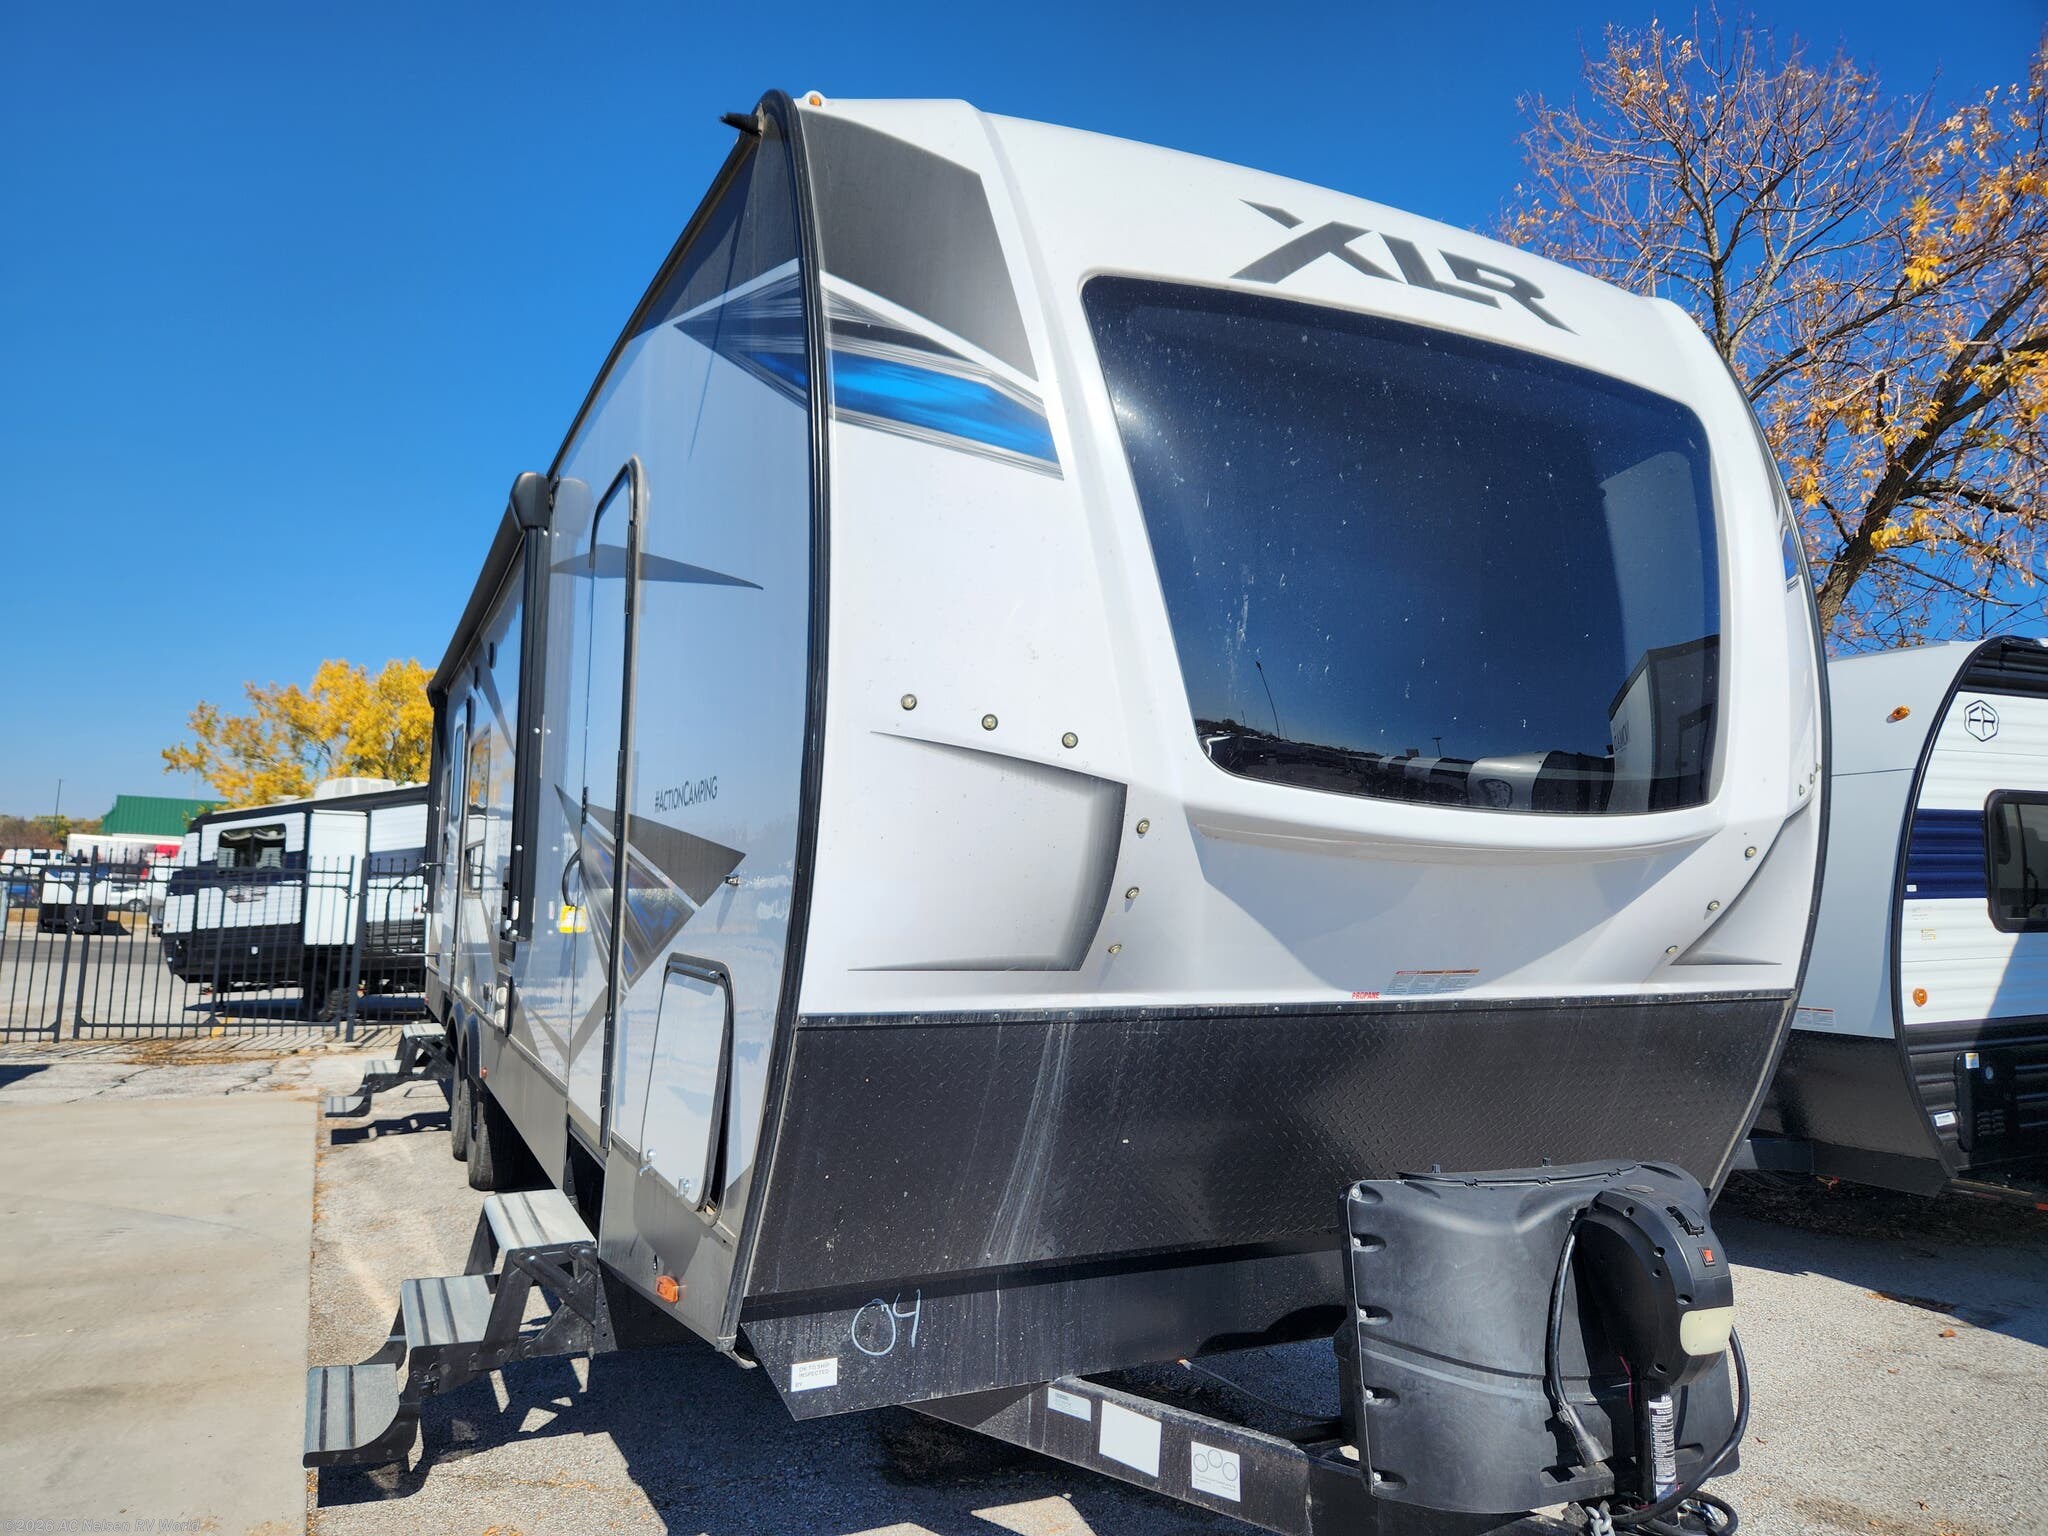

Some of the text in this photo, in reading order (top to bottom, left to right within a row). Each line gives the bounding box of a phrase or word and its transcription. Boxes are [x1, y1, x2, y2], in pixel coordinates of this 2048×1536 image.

[1230, 199, 1580, 335] XLR
[1352, 991, 1380, 1000] PROPANE
[851, 1288, 921, 1356] 04
